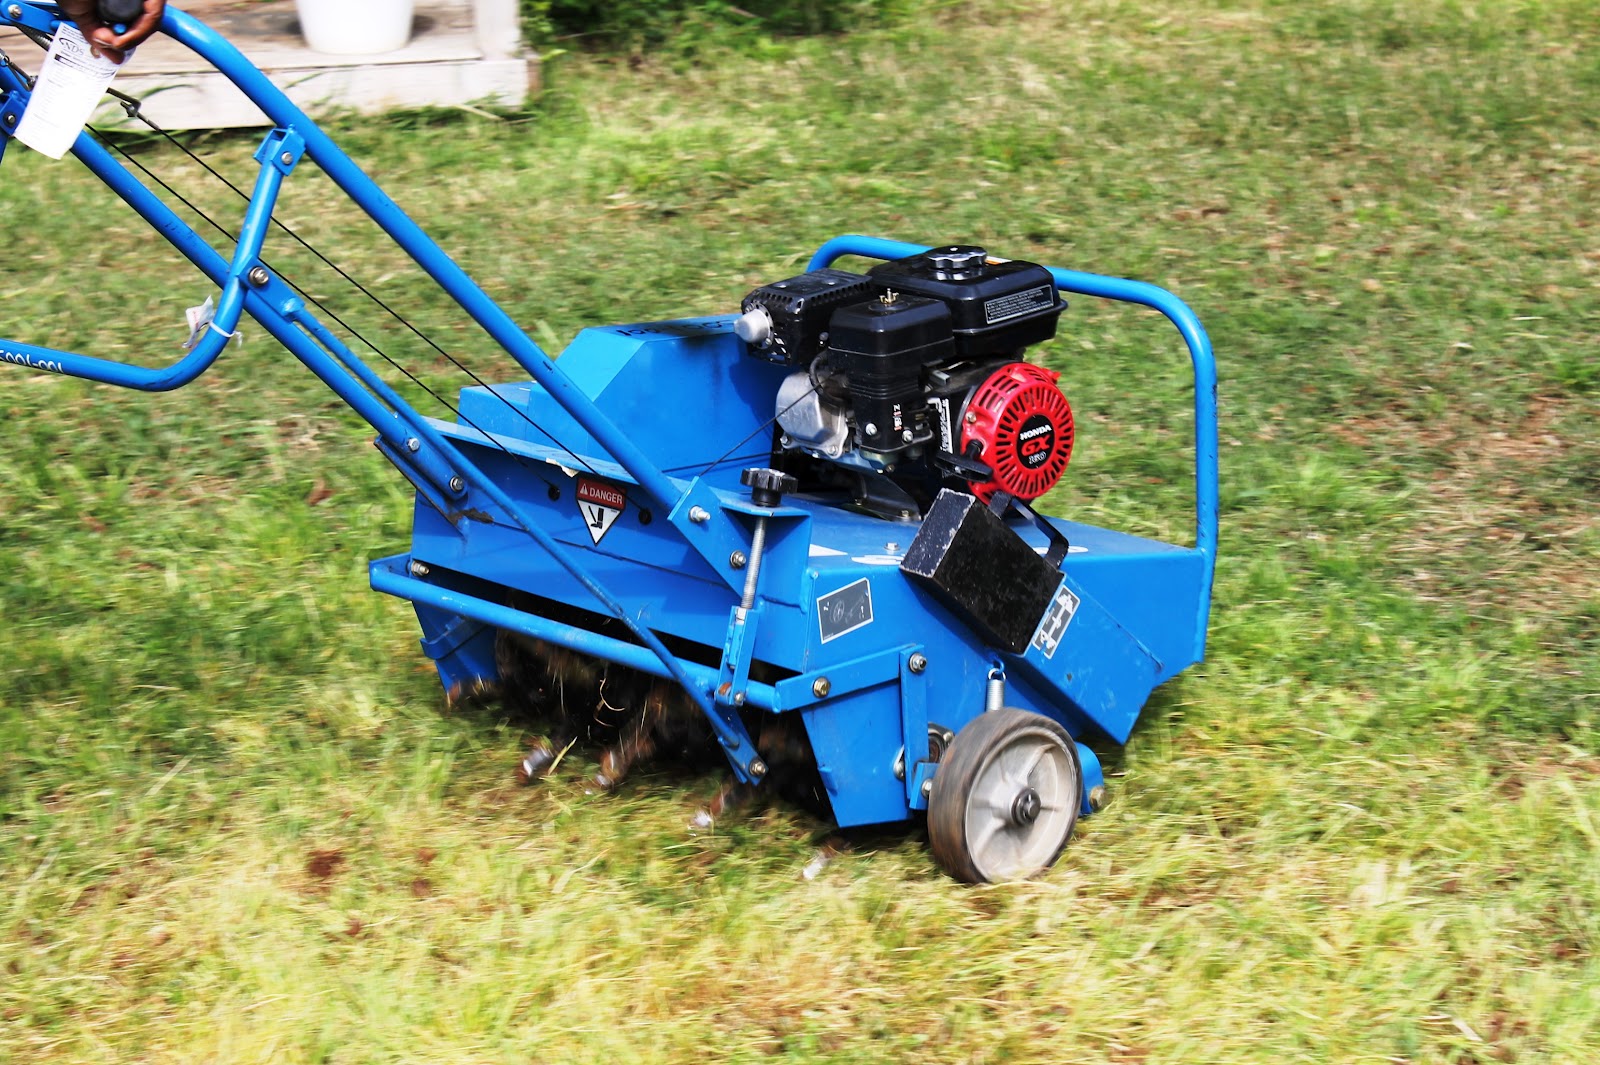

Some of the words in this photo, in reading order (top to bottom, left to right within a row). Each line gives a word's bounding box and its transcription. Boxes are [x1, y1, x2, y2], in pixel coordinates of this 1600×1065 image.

[1019, 424, 1052, 441] HONDA
[1021, 434, 1050, 456] GX
[589, 487, 623, 504] DANGER
